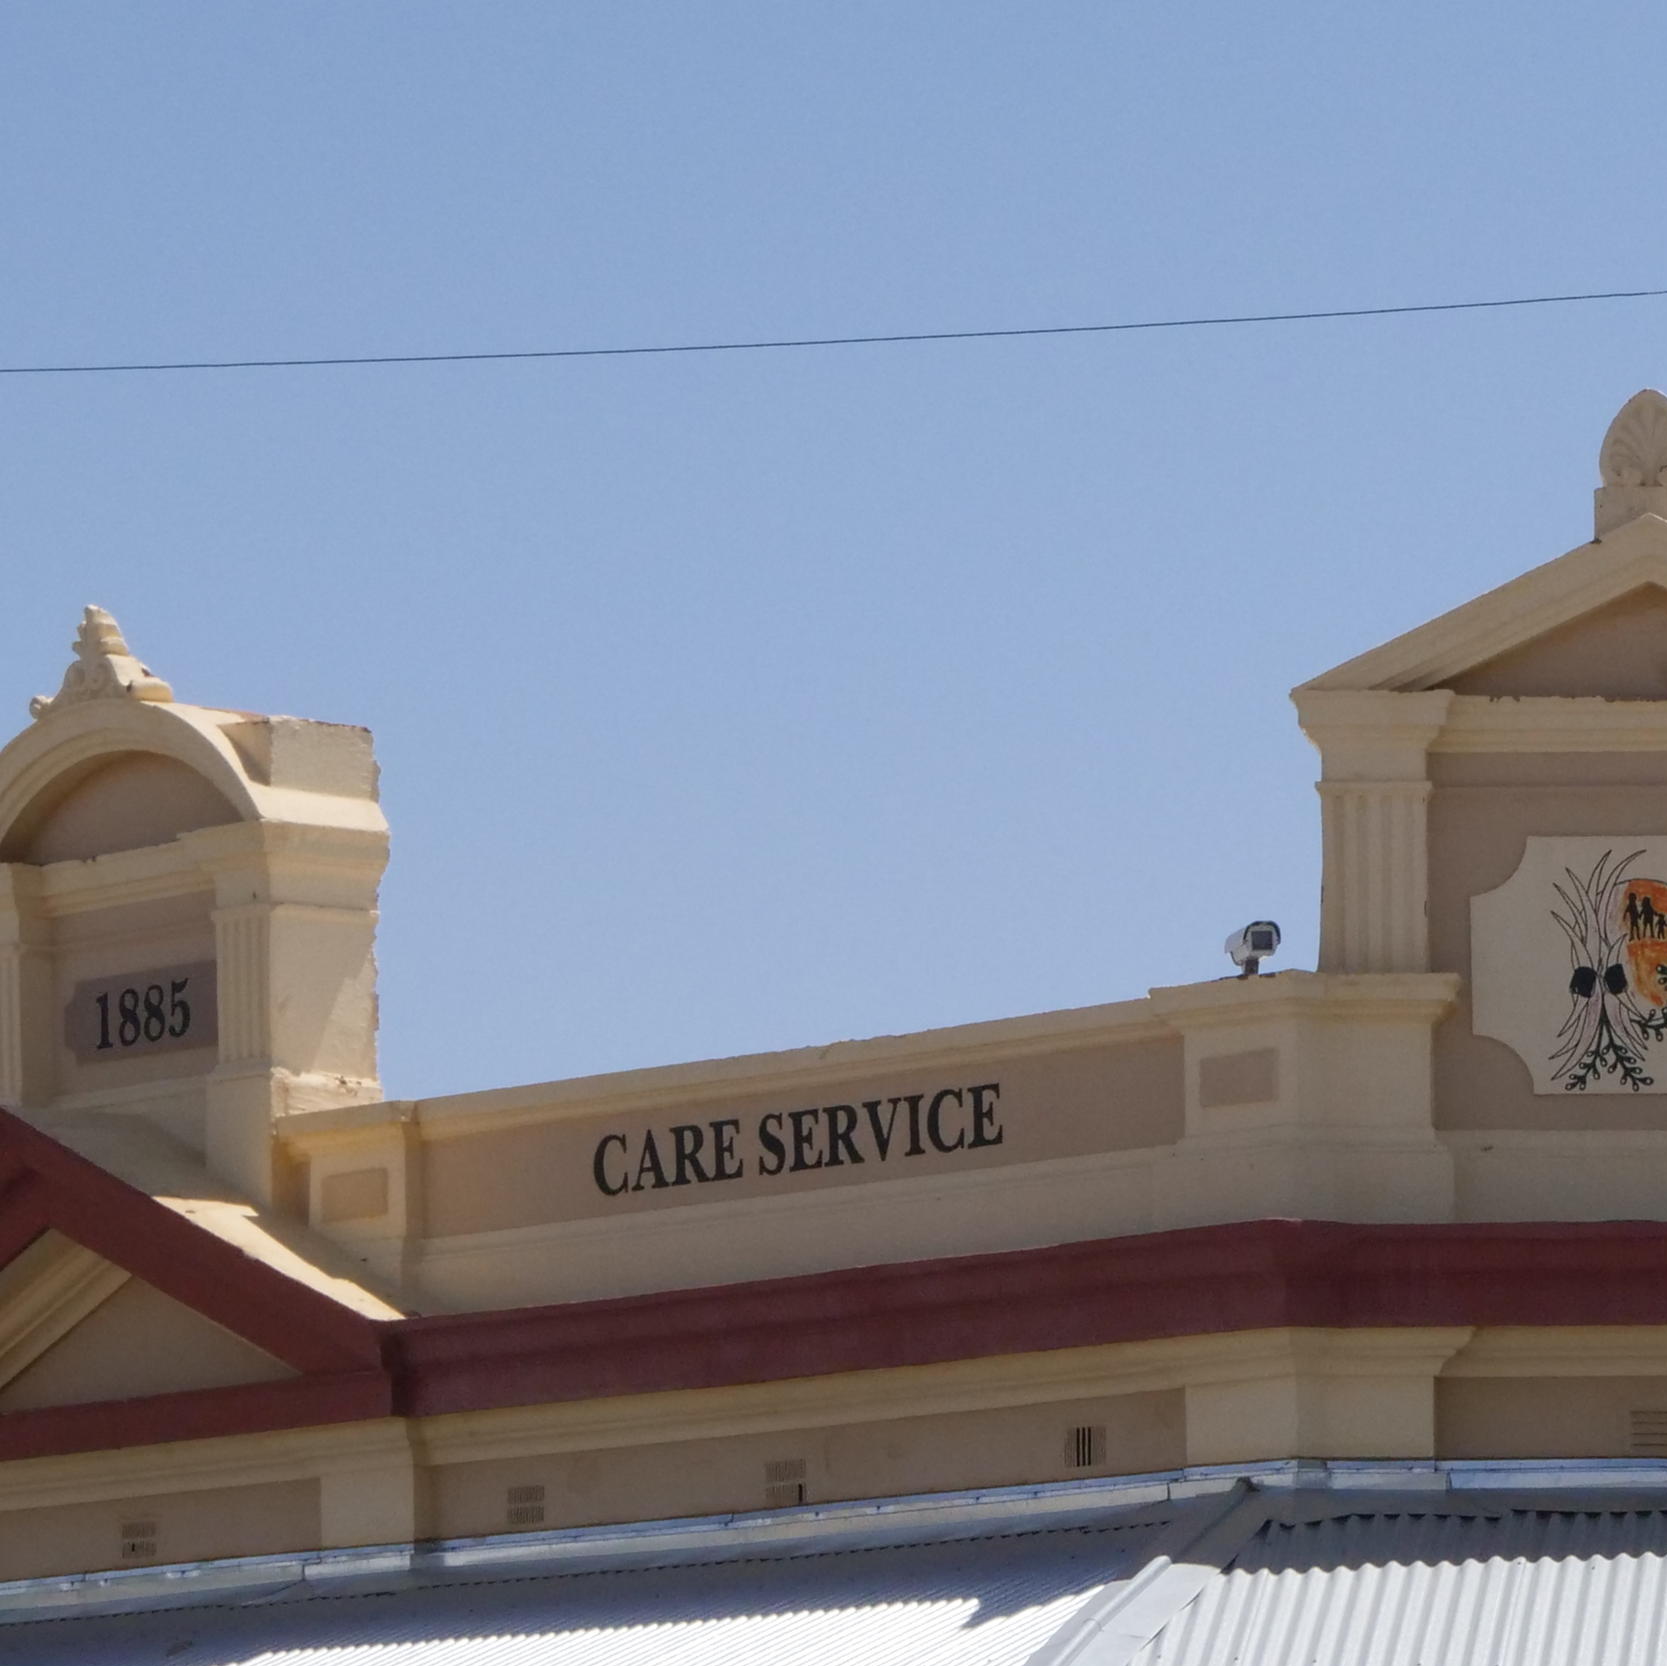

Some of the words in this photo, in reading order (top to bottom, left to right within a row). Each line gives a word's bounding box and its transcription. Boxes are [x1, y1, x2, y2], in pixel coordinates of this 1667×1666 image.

[96, 977, 191, 1050] 1885
[593, 1118, 744, 1196] CARE
[758, 1083, 1003, 1176] SERVICE
